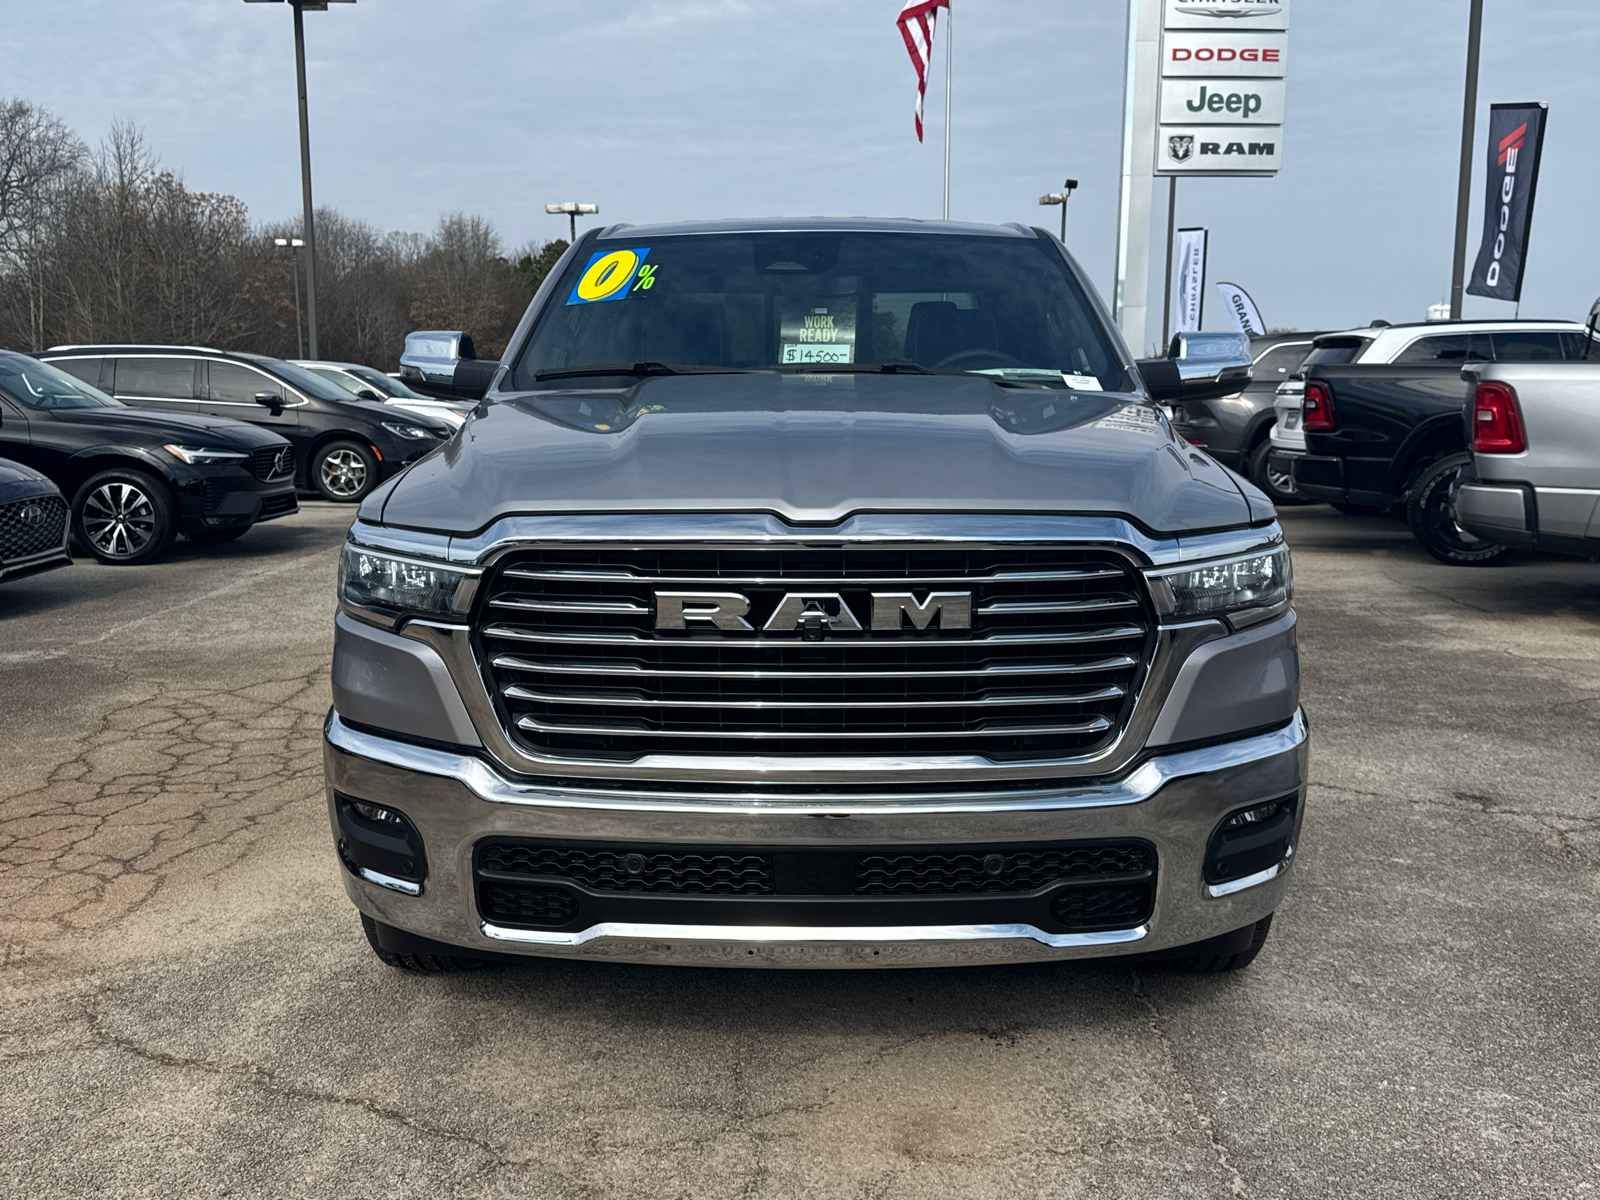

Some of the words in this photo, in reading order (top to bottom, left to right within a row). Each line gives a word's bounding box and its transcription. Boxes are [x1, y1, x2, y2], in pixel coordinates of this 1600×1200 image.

[1172, 48, 1280, 62] DODGE
[1186, 86, 1261, 118] Jeep
[1200, 142, 1275, 155] RAM
[804, 316, 834, 328] WORK
[800, 329, 839, 342] READY
[654, 591, 972, 630] RAM
